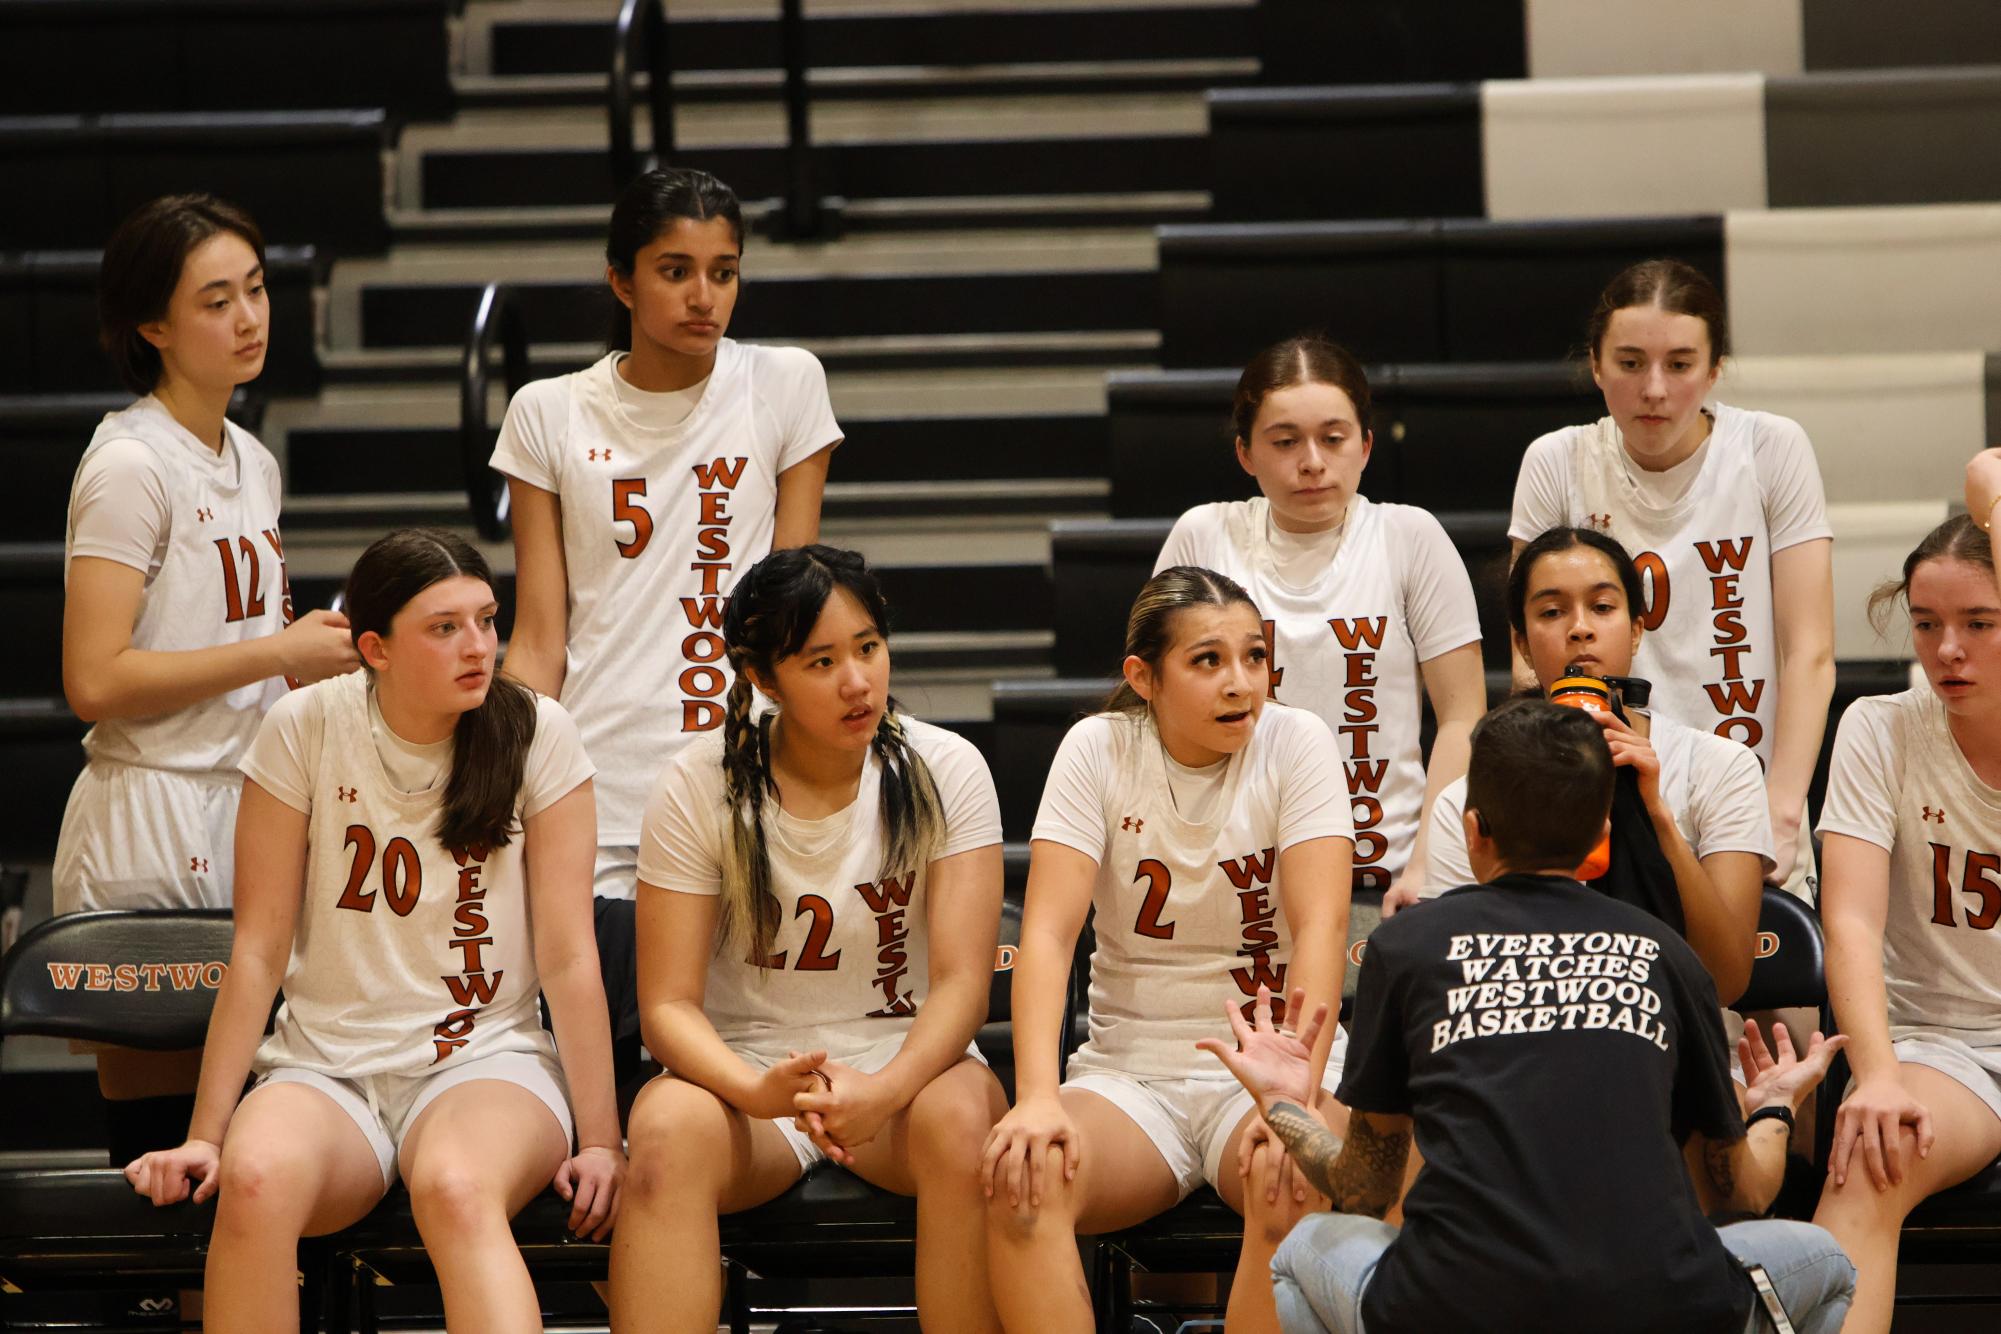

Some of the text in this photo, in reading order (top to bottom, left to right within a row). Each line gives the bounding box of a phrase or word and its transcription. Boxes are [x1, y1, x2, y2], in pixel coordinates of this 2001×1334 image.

[612, 478, 654, 559] 5
[213, 535, 265, 623] 12
[678, 457, 749, 732] WESTWOOD
[1328, 616, 1392, 890] WESTWOOD
[337, 825, 422, 916] 20
[1133, 859, 1175, 940] 2
[1928, 842, 2001, 930] 15
[47, 961, 229, 991] WESTWO
[1446, 932, 1660, 961] EVERYONE
[1461, 955, 1650, 984] WATCHES
[1430, 1003, 1669, 1053] BASKETBALL
[1447, 978, 1662, 1015] WESTWOOD
